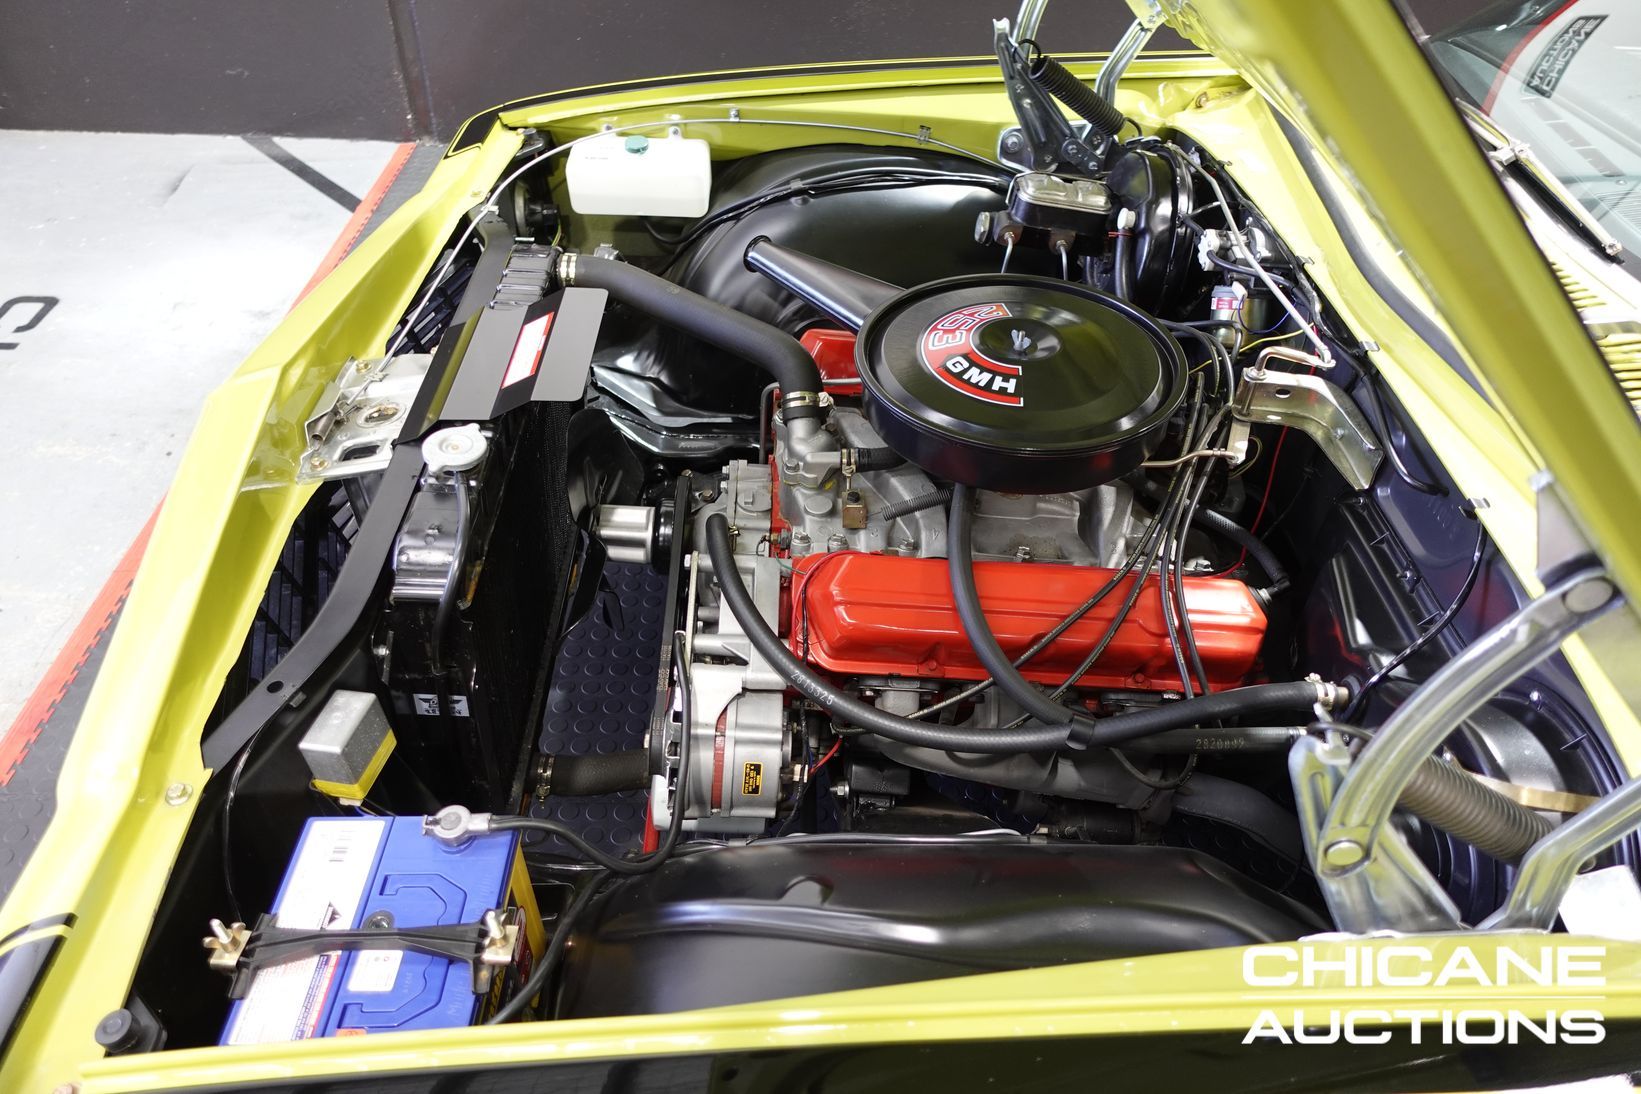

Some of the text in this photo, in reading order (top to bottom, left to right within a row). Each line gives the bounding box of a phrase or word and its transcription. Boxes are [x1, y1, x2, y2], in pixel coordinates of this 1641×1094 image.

[928, 305, 1004, 351] 253
[946, 356, 1017, 394] GMH
[791, 670, 835, 706] 2813325
